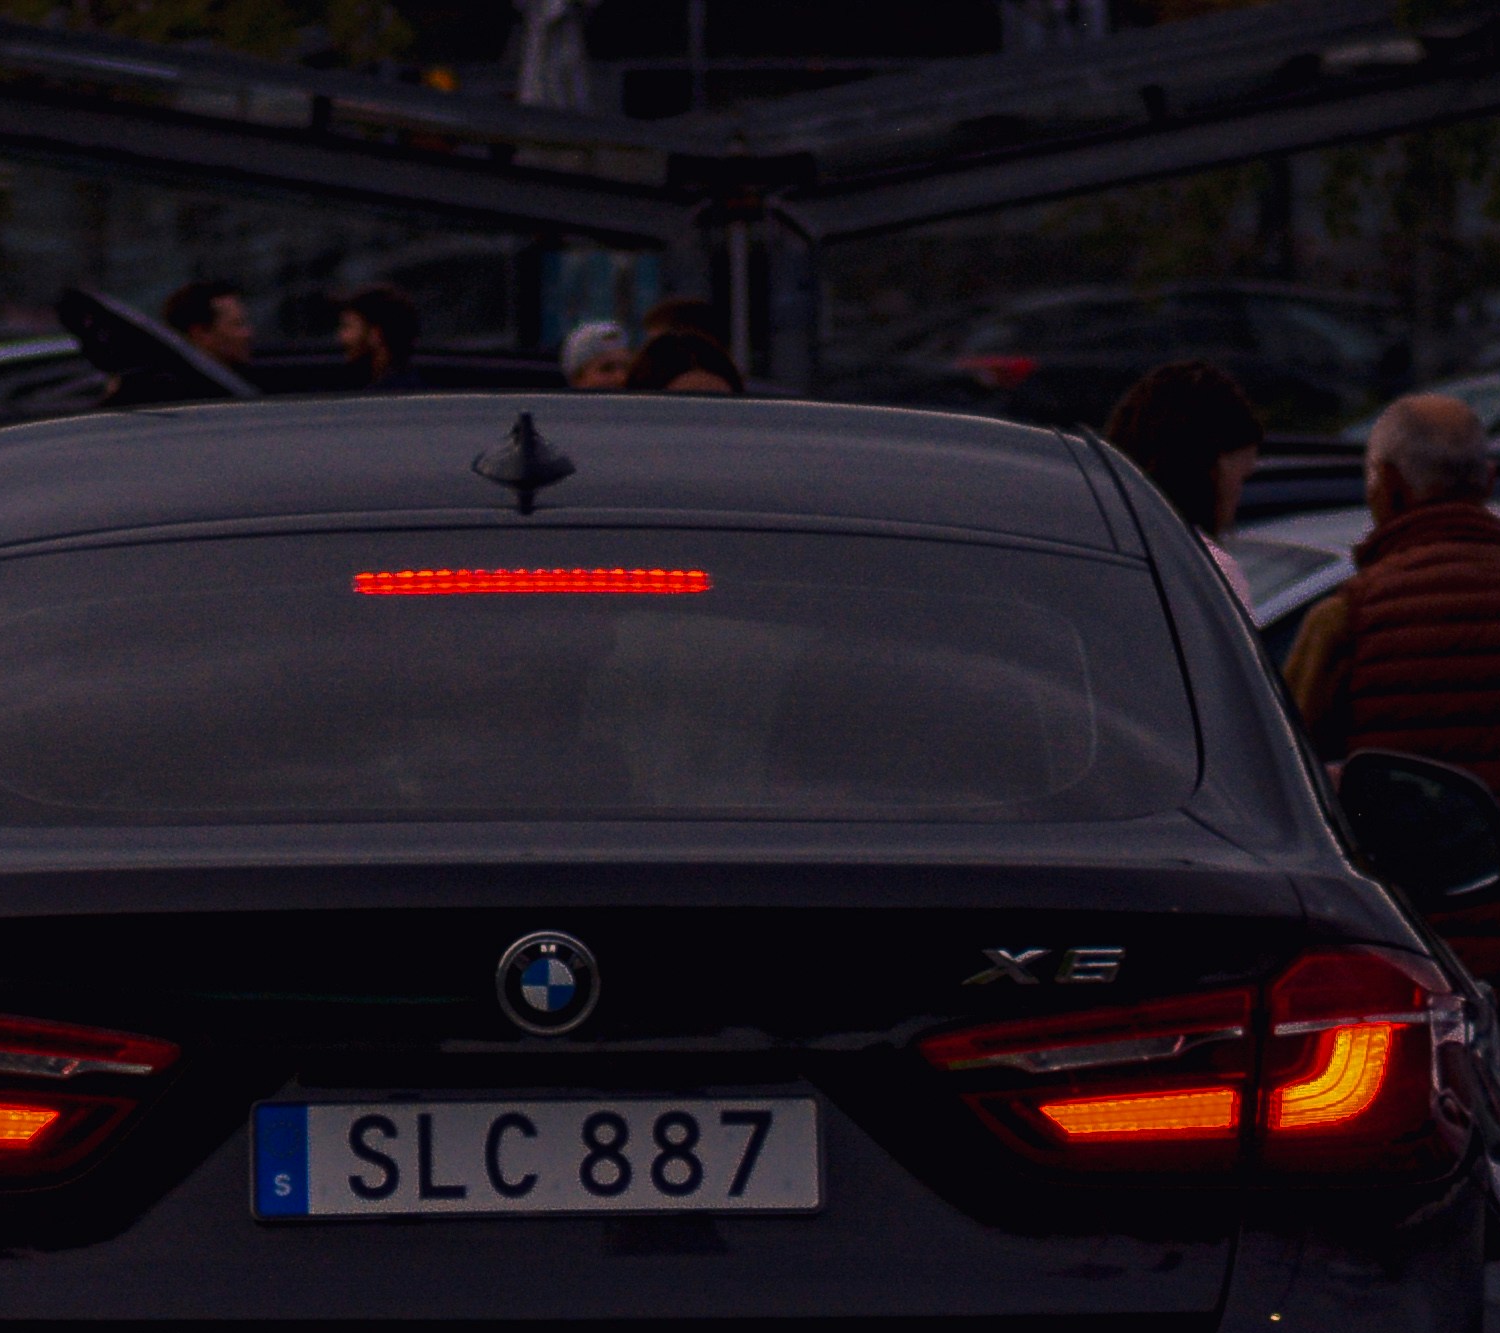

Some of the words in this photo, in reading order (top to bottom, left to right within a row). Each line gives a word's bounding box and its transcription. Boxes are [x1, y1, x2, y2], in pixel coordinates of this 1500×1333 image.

[959, 946, 1128, 986] X6
[348, 1112, 539, 1201] SLC
[579, 1110, 773, 1197] 887
[274, 1173, 292, 1197] S
